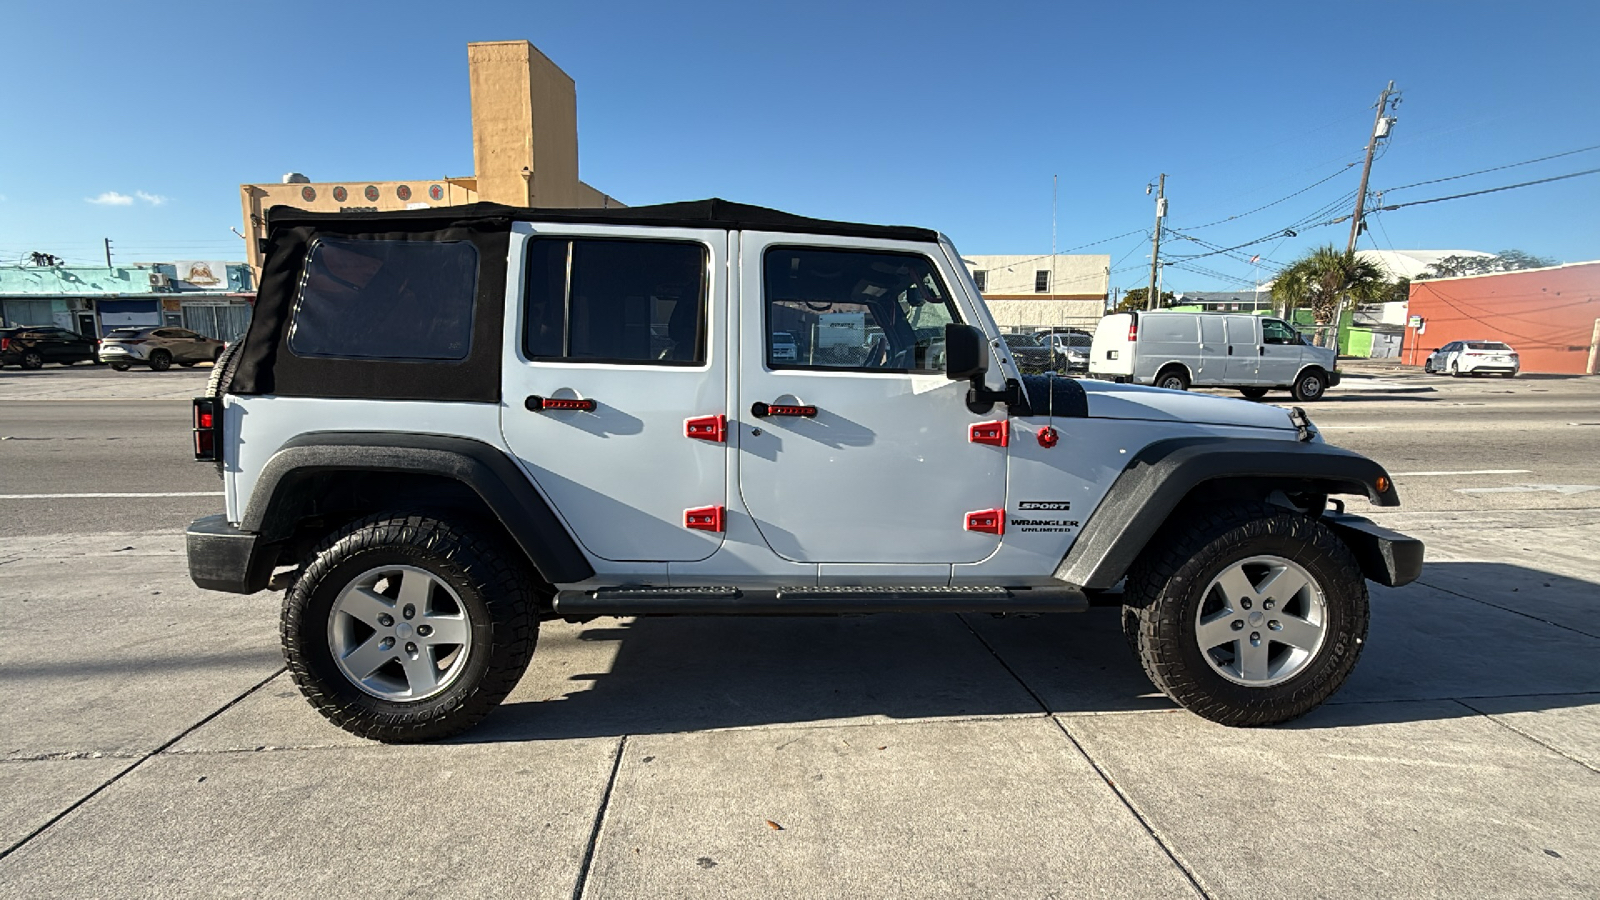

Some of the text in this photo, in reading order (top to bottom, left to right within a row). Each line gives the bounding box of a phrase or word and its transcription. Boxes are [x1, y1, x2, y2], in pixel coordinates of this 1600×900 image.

[1019, 502, 1070, 510] SPORT
[1011, 519, 1079, 527] WRANGLER
[417, 687, 468, 720] TOYO
